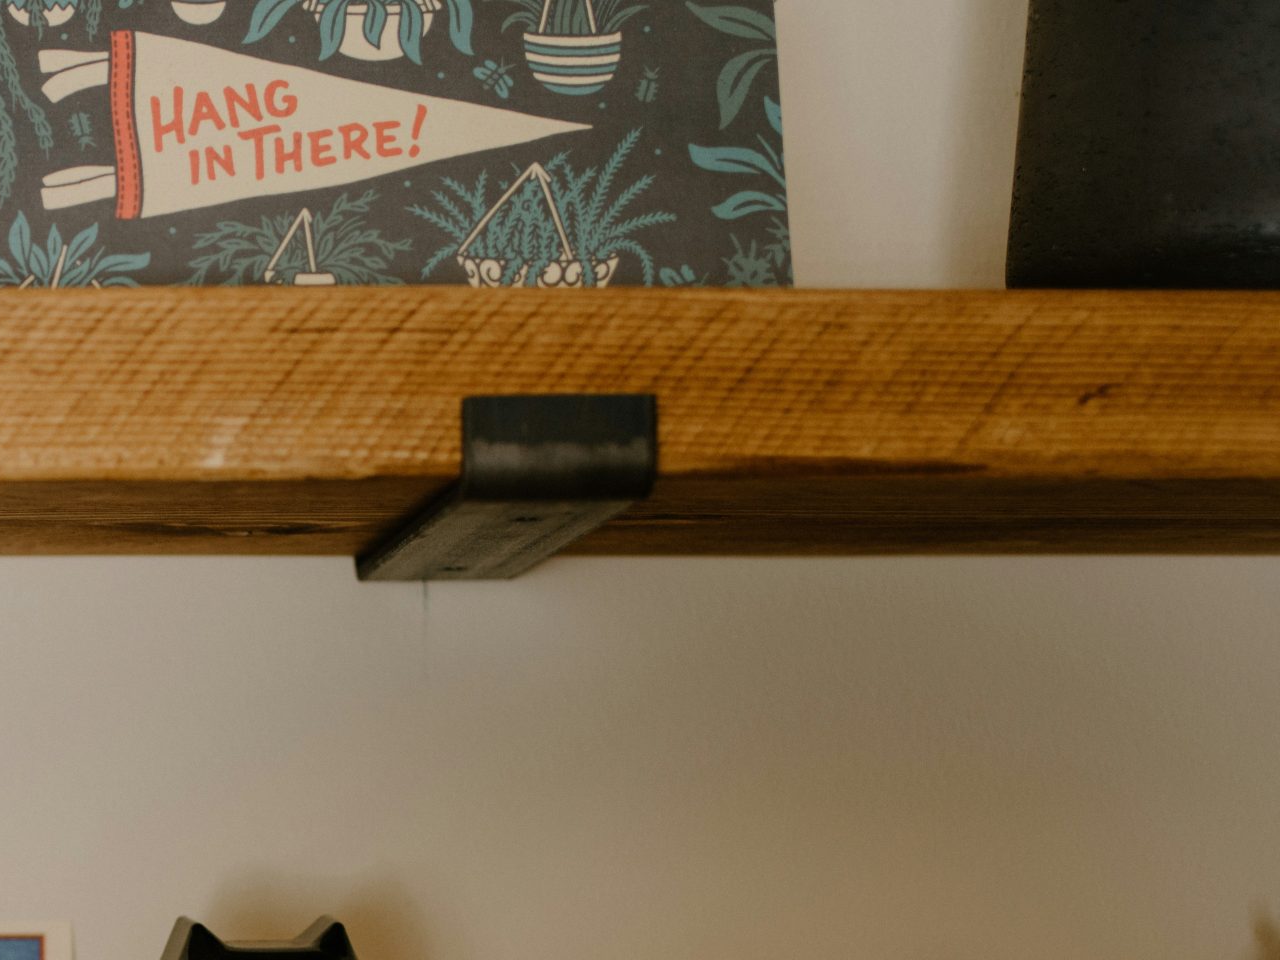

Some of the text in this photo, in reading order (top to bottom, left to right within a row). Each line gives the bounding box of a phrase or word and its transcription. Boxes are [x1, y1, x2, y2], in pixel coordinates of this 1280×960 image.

[150, 79, 299, 153] HANG
[188, 104, 428, 185] IN THERE!
